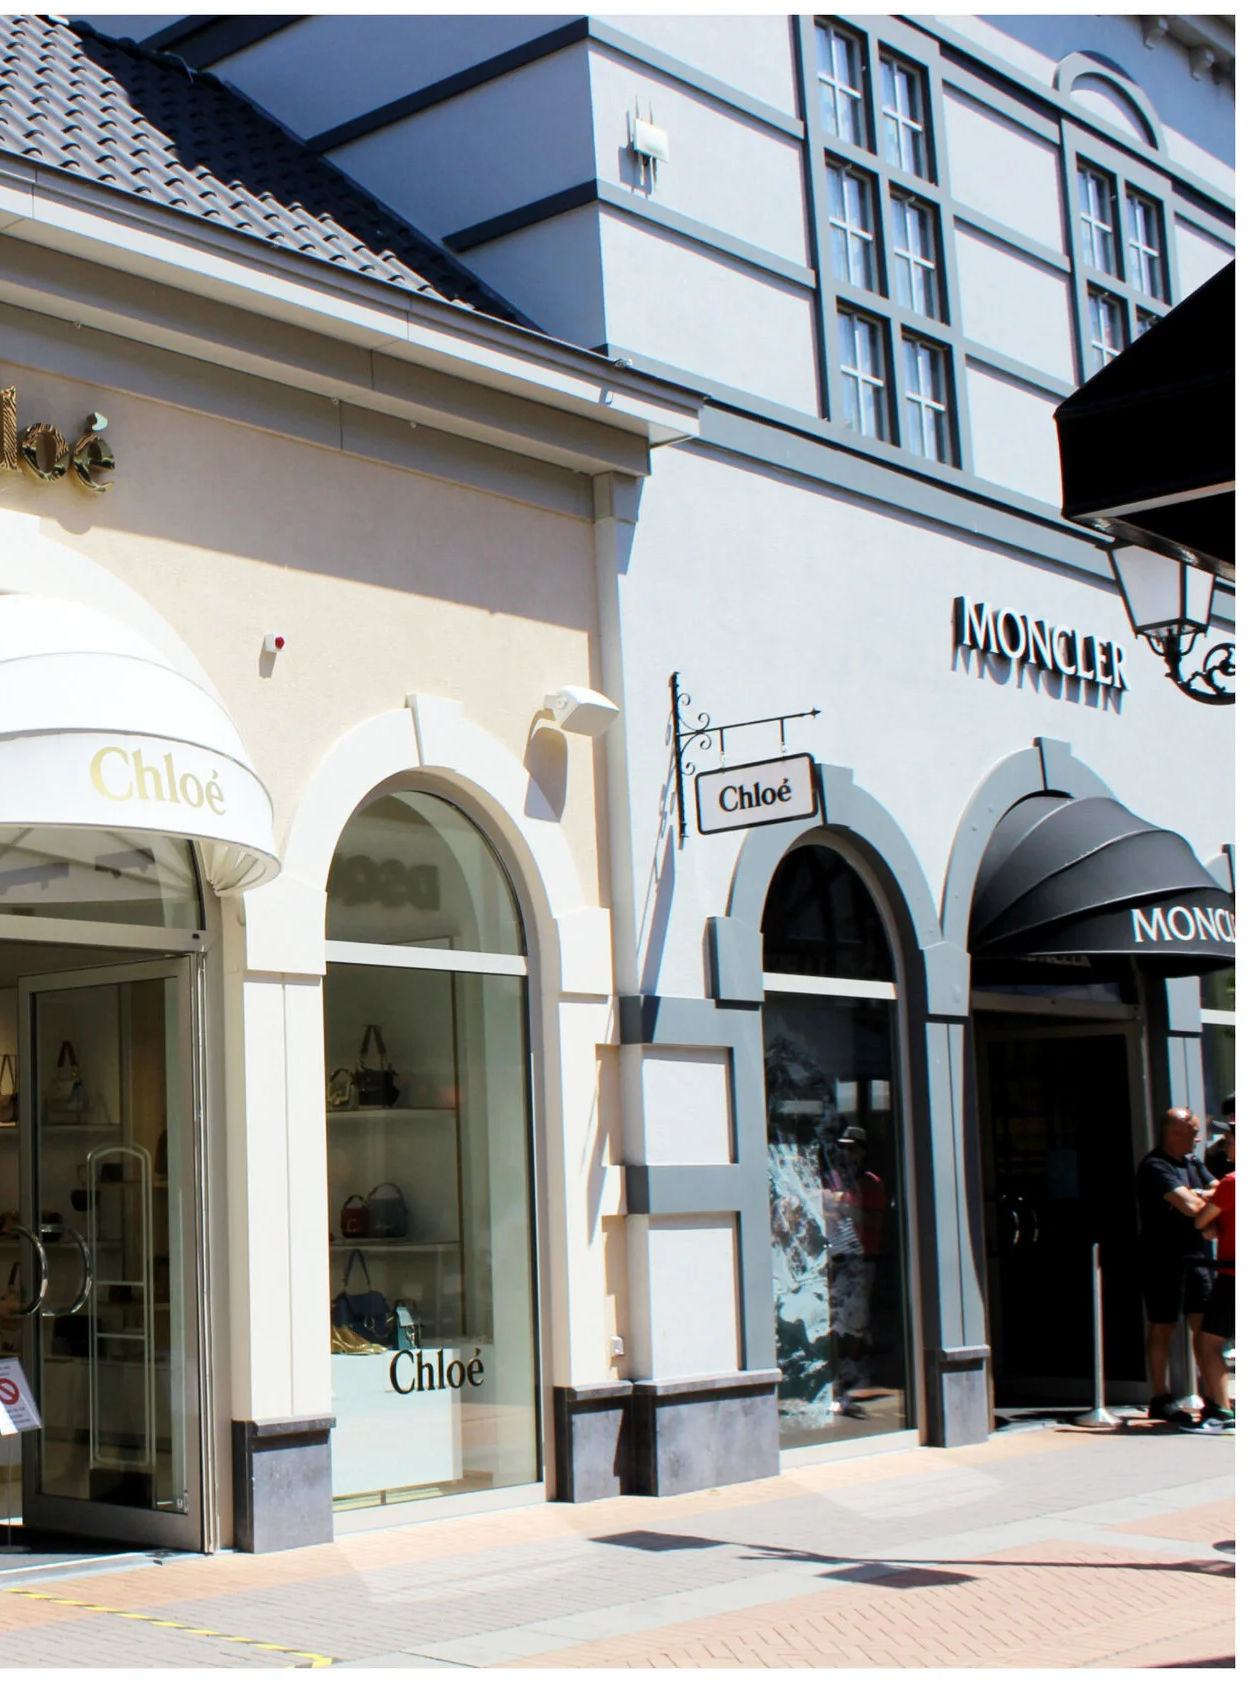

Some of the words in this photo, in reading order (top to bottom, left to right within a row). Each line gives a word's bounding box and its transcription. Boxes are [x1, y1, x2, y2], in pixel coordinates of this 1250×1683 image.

[953, 595, 1131, 692] MONCLER
[90, 746, 226, 816] Chloé
[718, 778, 792, 812] Chloé
[389, 1347, 485, 1395] Chloé
